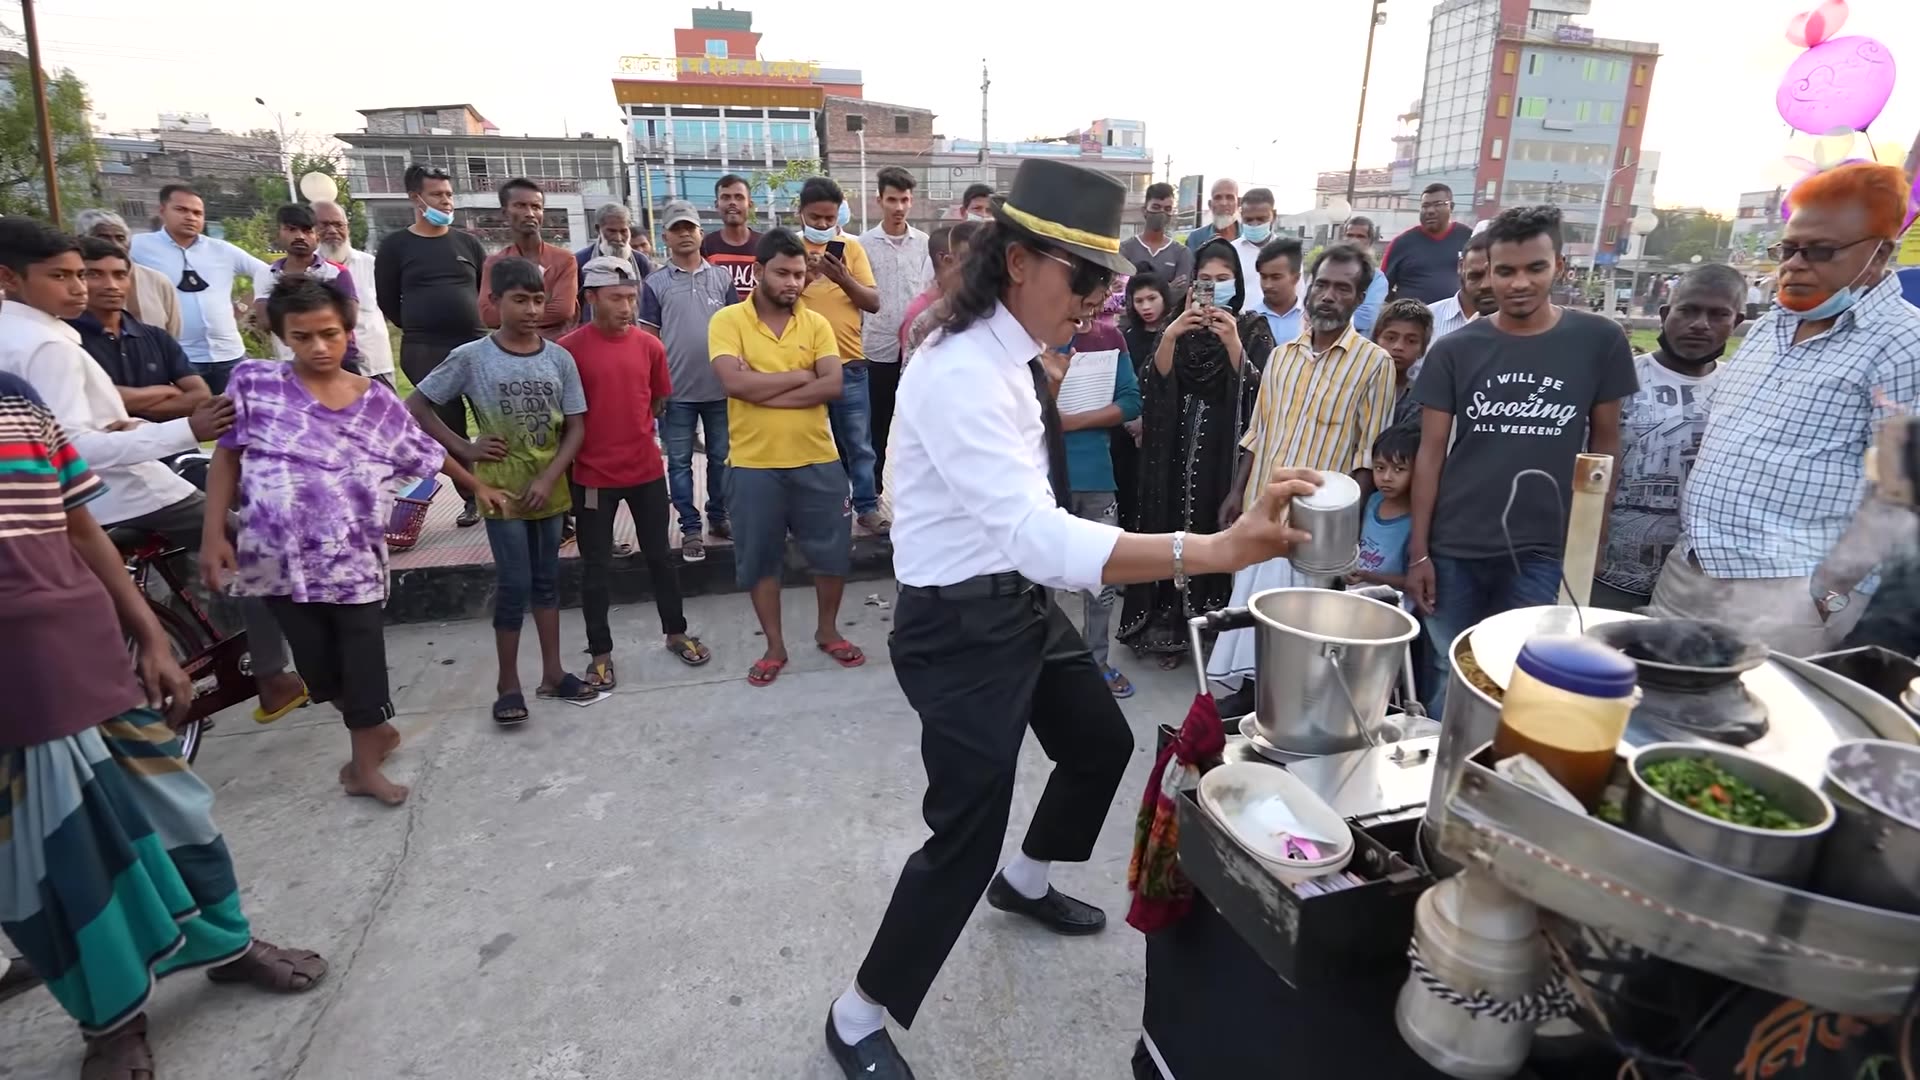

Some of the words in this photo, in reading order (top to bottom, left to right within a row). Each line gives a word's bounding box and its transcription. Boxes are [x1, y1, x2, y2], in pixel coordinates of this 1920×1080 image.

[498, 381, 554, 397] ROSES
[1486, 379, 1491, 388] I
[1496, 372, 1536, 384] WILL
[1542, 376, 1564, 391] BE
[1466, 391, 1577, 426] Snoozing
[515, 414, 553, 433] FOR
[1473, 423, 1495, 432] ALL
[1500, 424, 1562, 436] WEEKEND
[518, 432, 547, 448] YOU
